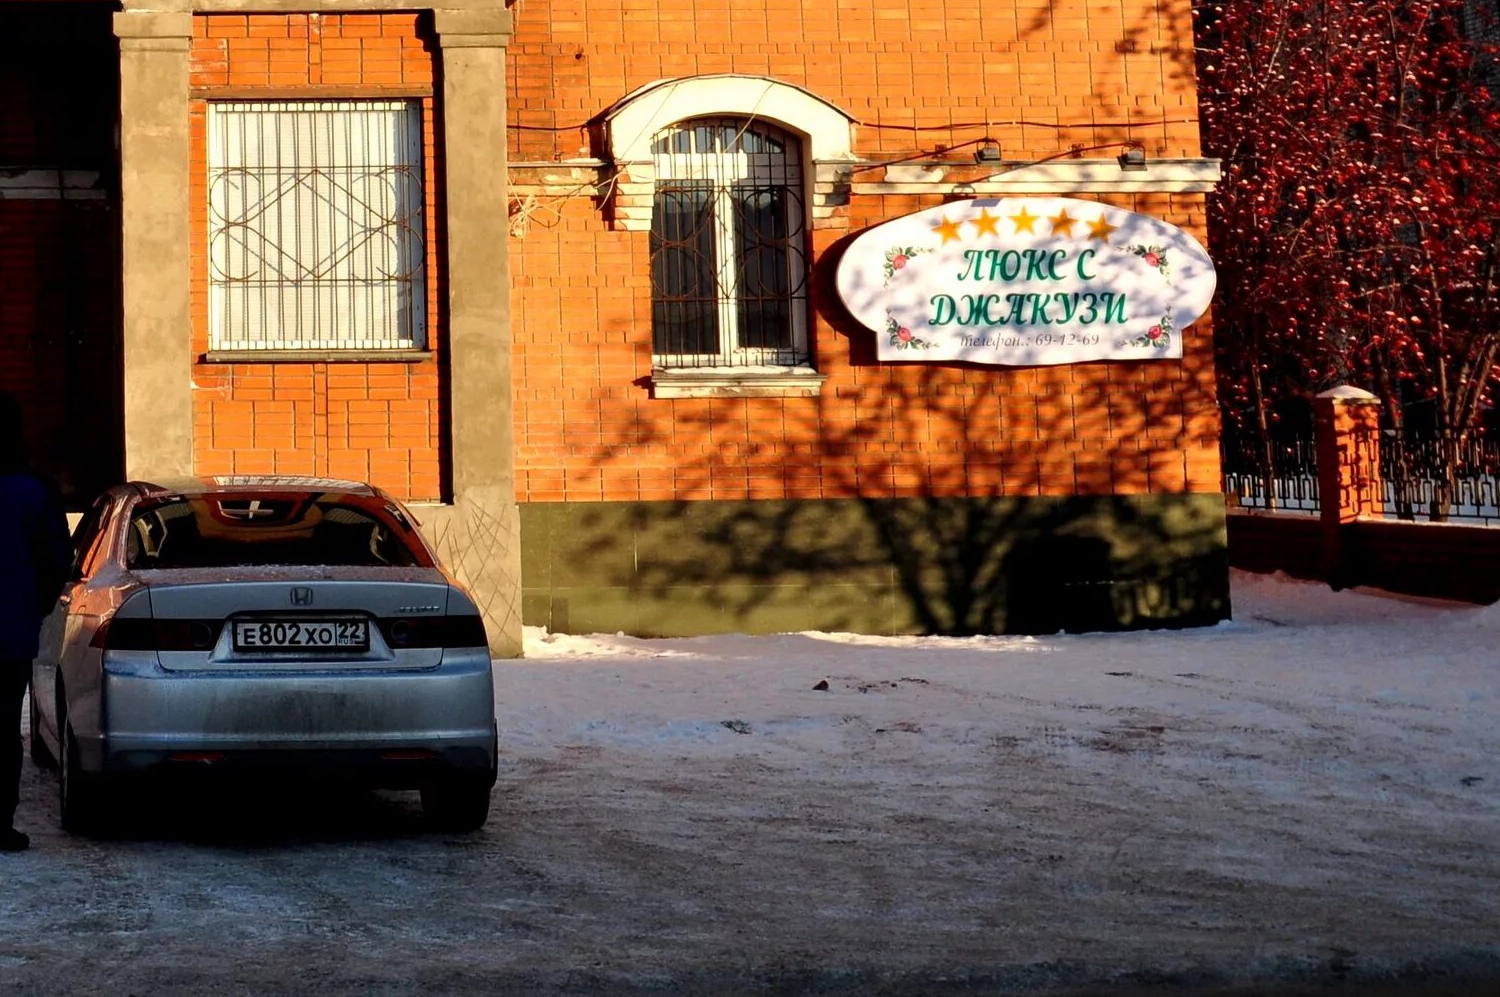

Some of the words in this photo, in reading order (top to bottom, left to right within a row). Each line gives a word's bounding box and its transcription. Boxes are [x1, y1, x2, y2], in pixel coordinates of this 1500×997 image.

[957, 249, 1068, 282] ЛЮКС
[1077, 249, 1098, 281] С
[928, 292, 1130, 326] ДЖАКУЗИ
[1034, 333, 1101, 347] 69-12-69
